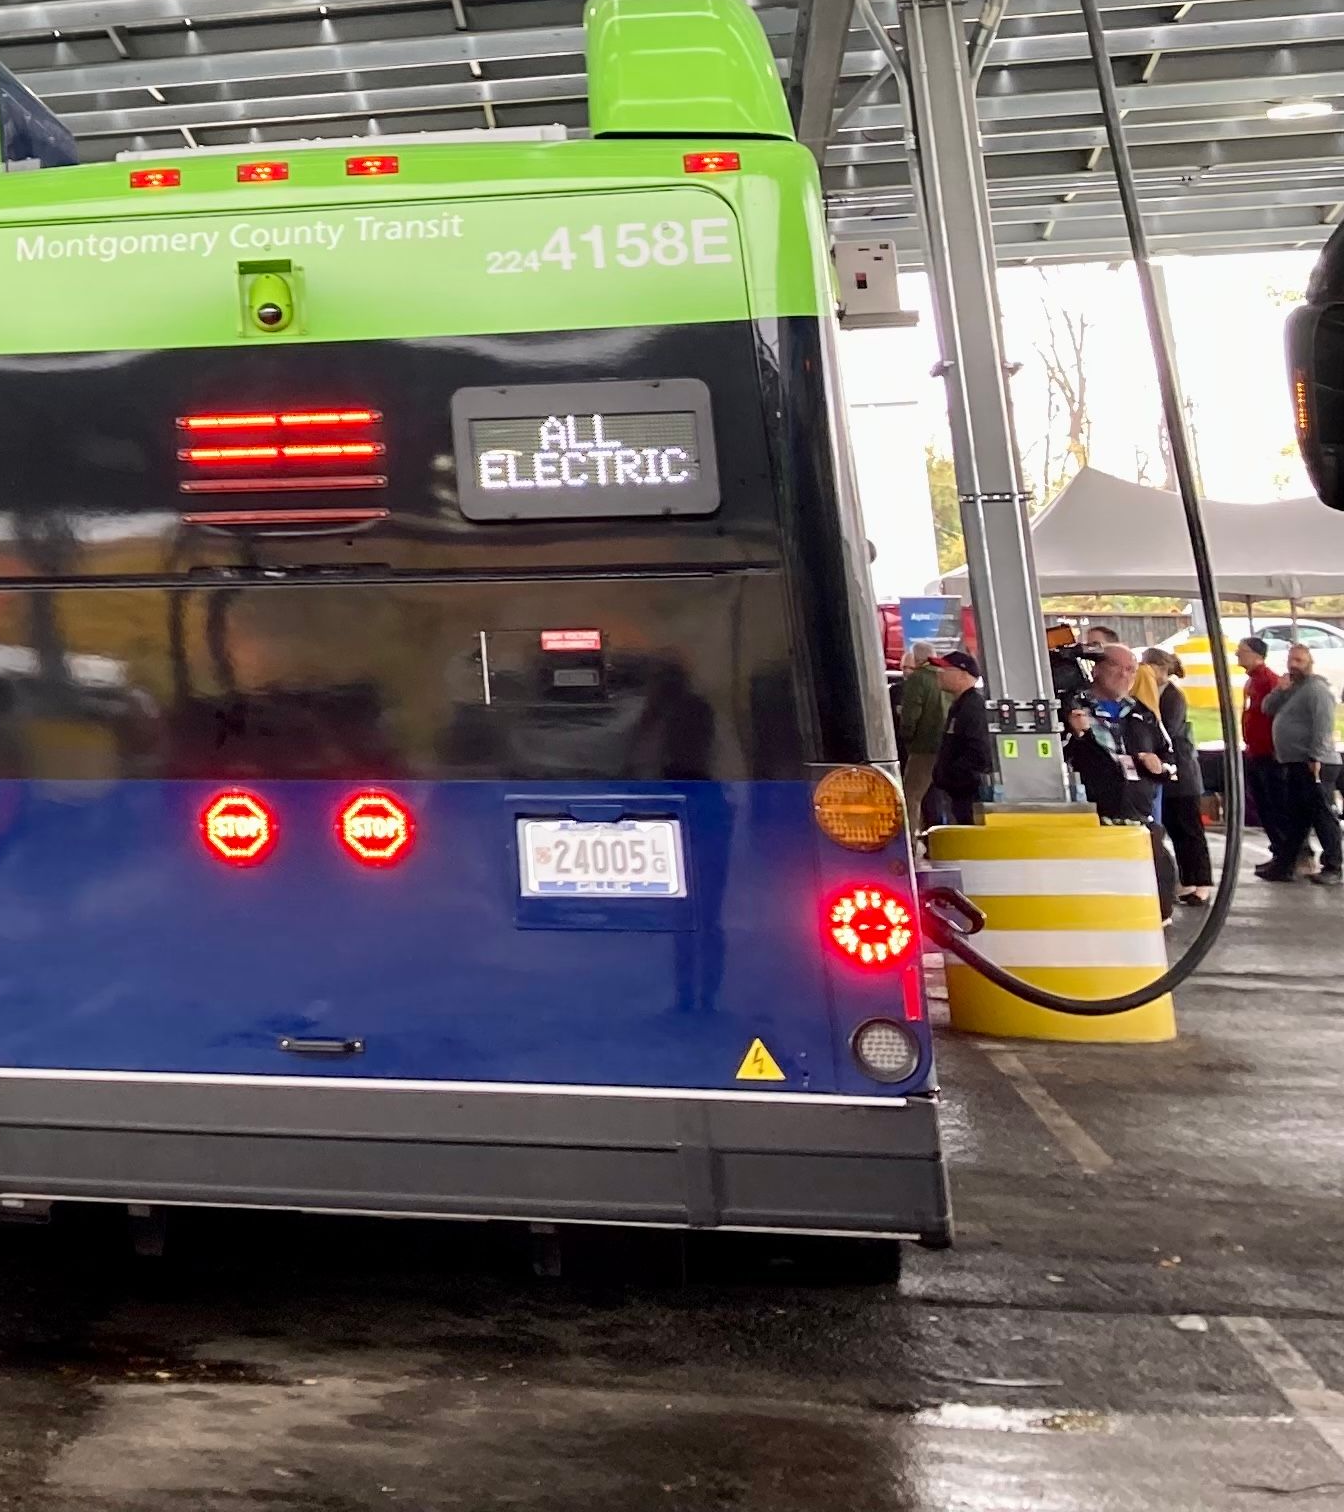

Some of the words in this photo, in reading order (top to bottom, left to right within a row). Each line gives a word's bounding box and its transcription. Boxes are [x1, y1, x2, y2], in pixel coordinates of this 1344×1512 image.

[16, 229, 218, 262] Montgomery
[229, 221, 344, 252] County
[353, 213, 464, 242] Transit
[540, 414, 623, 450] ALL
[479, 447, 689, 488] ELECTRIC
[1007, 742, 1014, 754] 7
[214, 815, 261, 838] STOP
[351, 815, 398, 838] STOP
[554, 839, 647, 874] 24005
